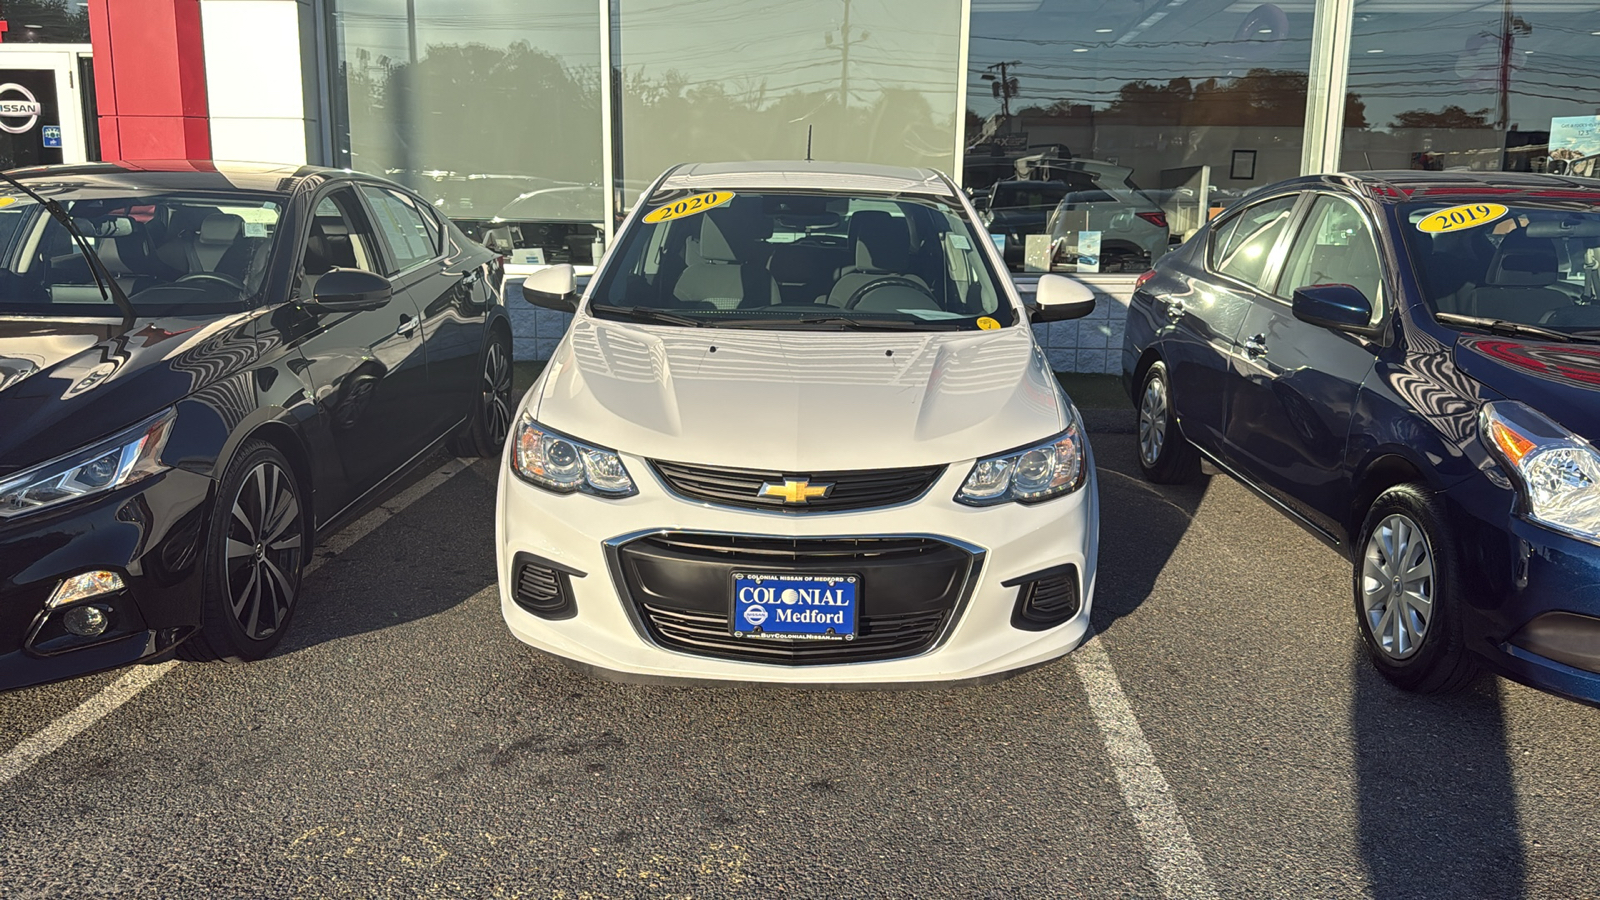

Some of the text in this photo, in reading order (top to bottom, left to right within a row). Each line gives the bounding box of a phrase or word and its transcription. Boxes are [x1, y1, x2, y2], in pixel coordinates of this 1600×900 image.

[660, 193, 717, 220] 2020
[1436, 205, 1490, 229] 2019
[775, 608, 844, 624] Medford
